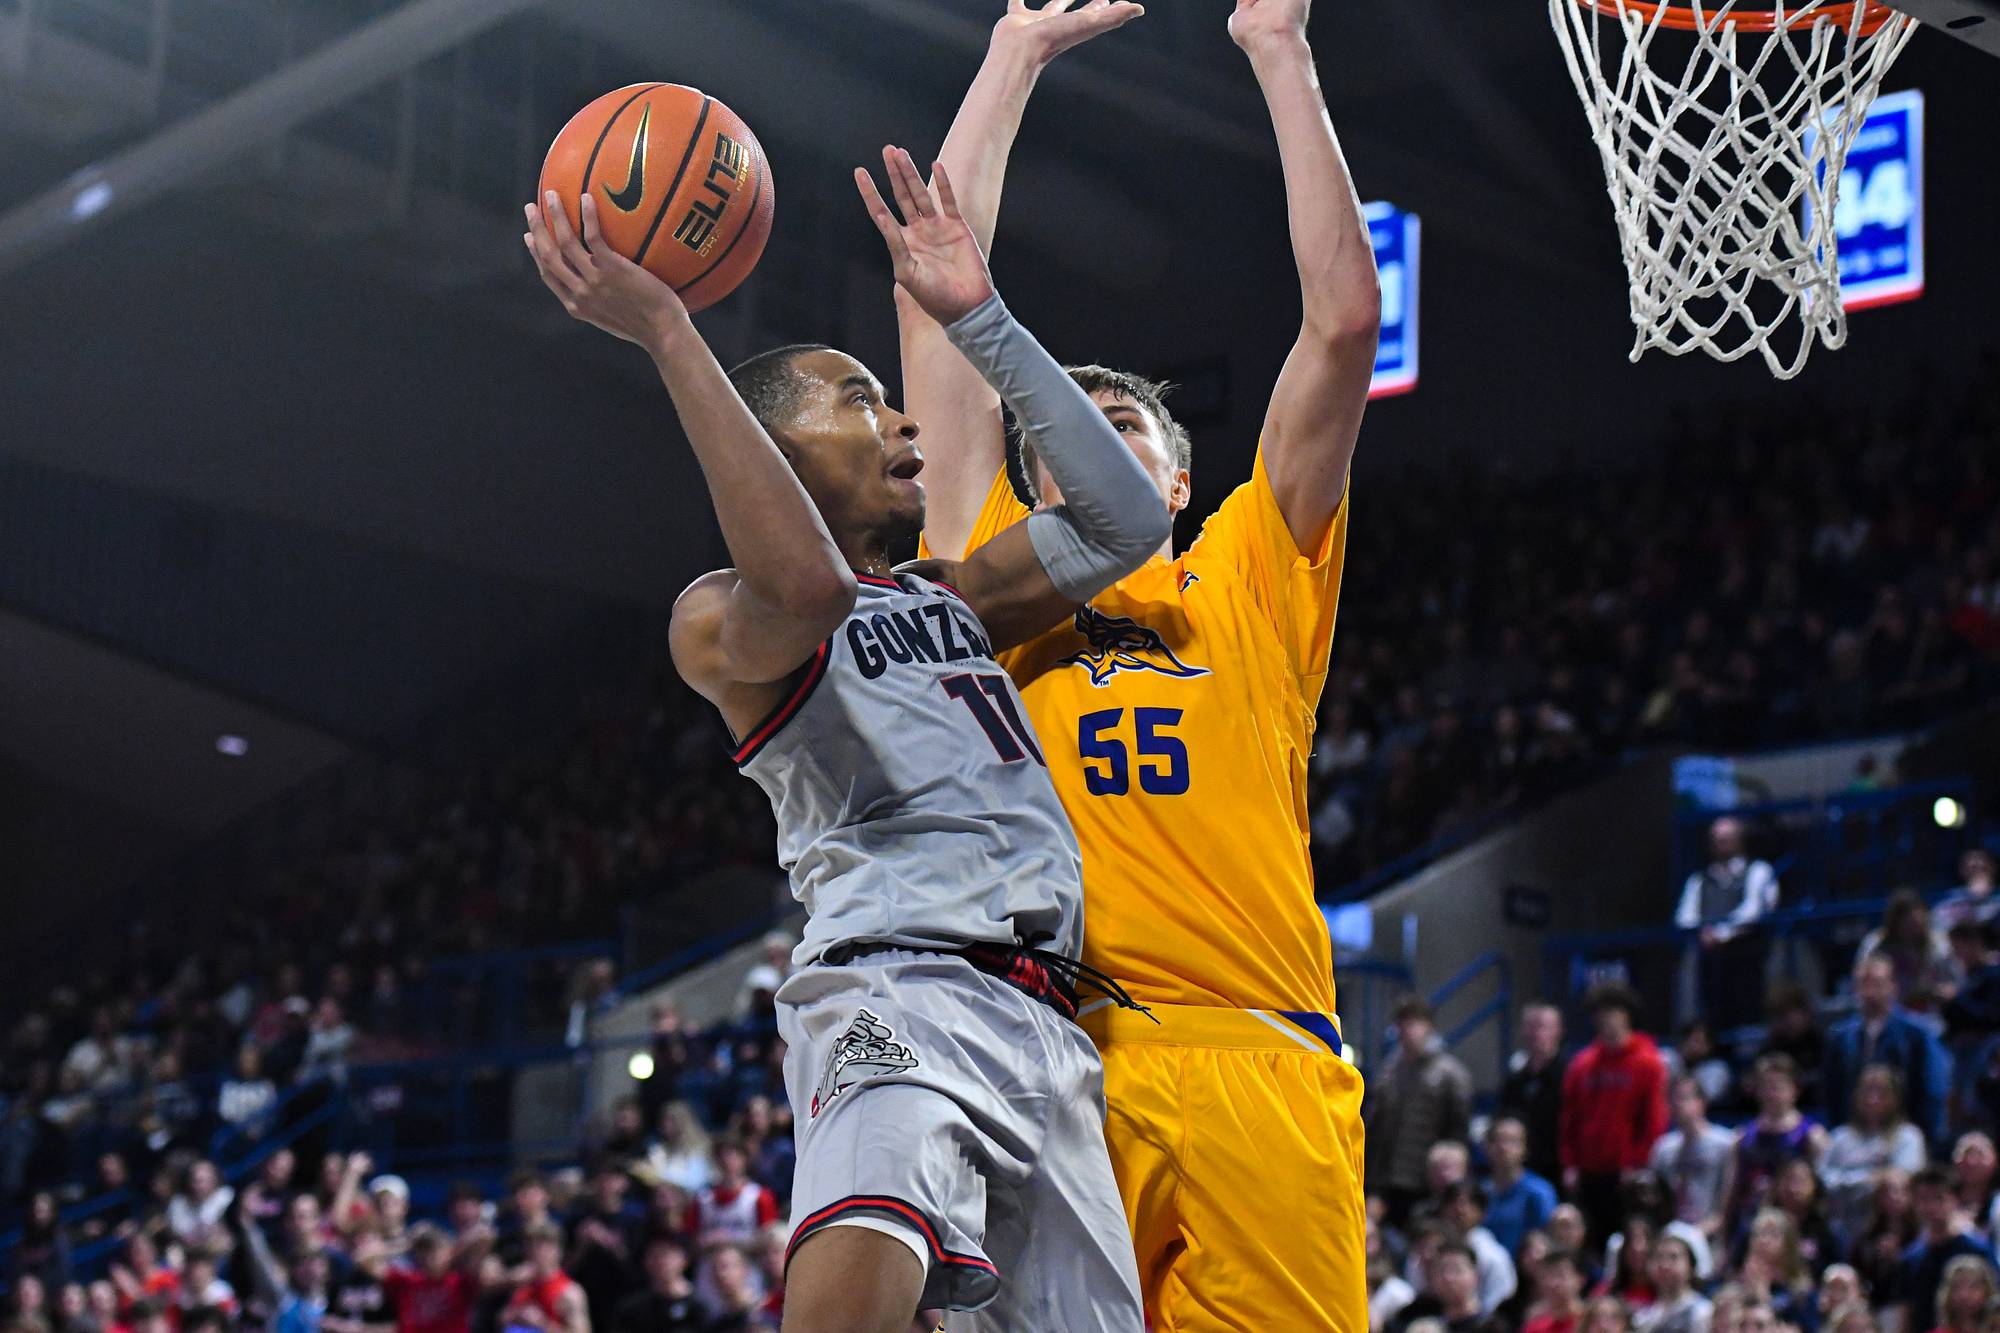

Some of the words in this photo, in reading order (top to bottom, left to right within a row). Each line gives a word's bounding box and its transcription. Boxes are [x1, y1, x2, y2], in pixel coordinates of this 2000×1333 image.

[673, 131, 742, 253] ELITE
[940, 672, 1047, 767] 11
[1079, 707, 1190, 796] 55
